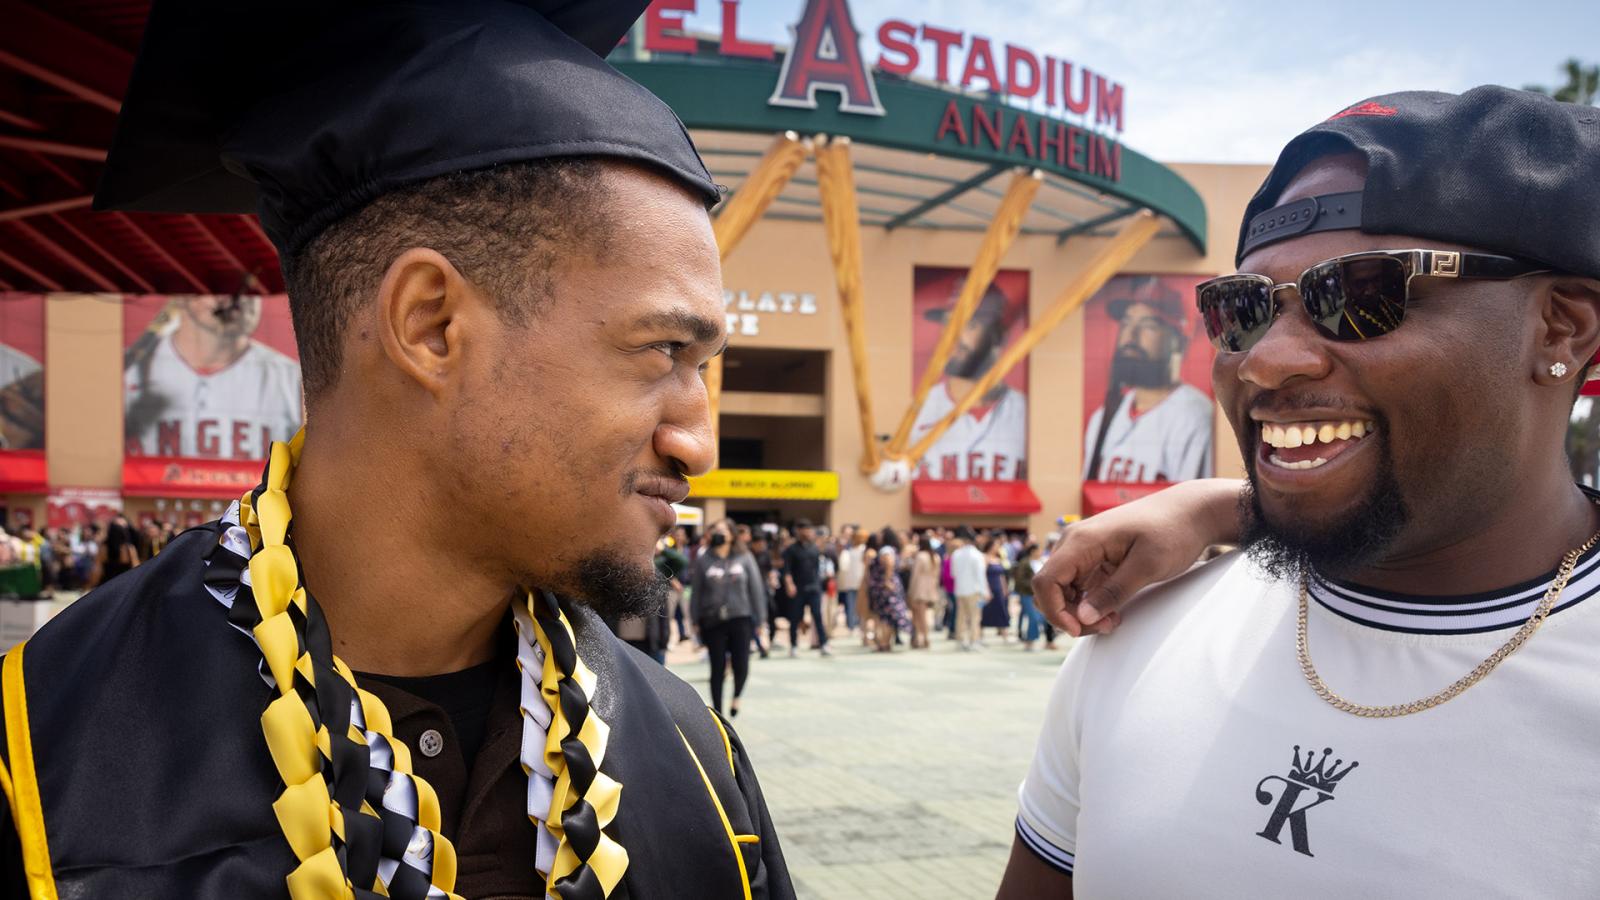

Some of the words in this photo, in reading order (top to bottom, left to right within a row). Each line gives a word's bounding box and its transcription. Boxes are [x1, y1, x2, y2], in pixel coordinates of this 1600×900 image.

[644, 0, 775, 60] EL
[876, 19, 1124, 133] STADIUM
[936, 99, 1122, 182] ANAHEIM
[724, 313, 759, 336] TE
[1255, 775, 1335, 858] K
